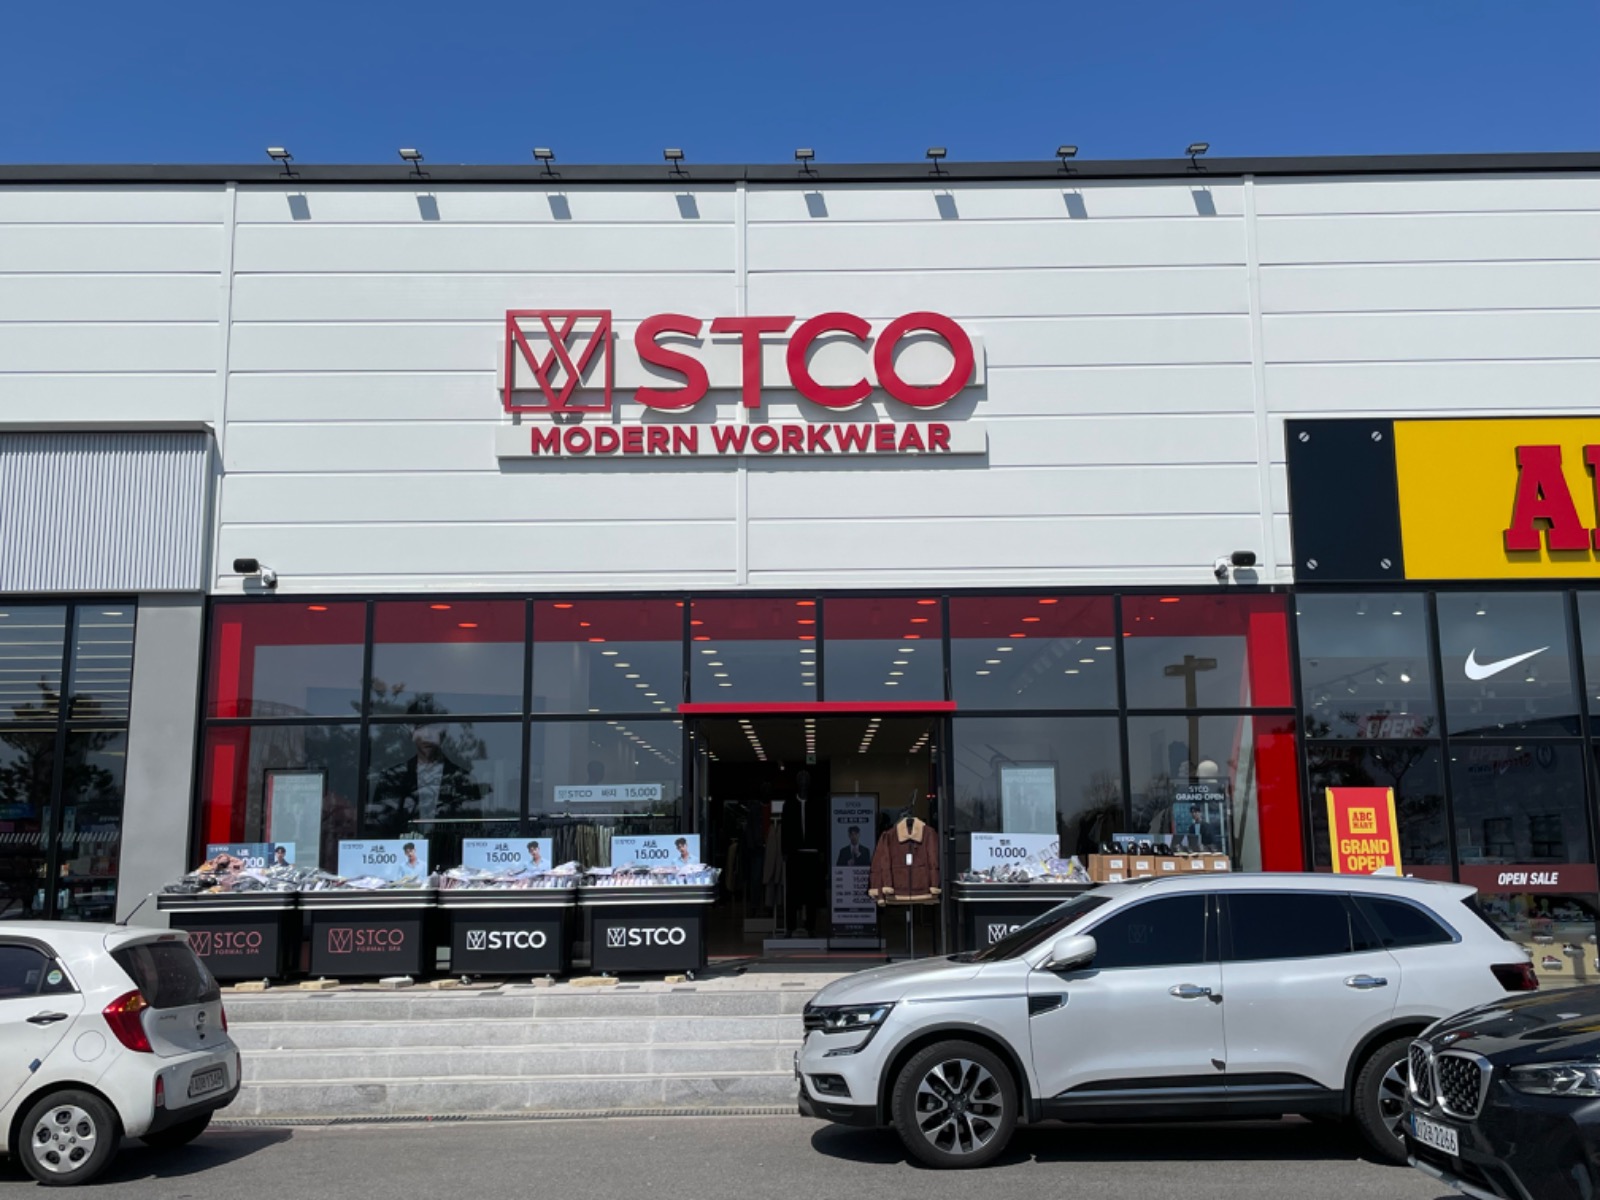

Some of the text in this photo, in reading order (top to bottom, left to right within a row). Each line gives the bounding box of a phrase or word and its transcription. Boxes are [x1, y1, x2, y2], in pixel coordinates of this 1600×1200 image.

[634, 310, 975, 411] STCO
[531, 422, 951, 455] MODERN WORKWEAR
[1504, 444, 1600, 552] A
[568, 790, 593, 798] STCO
[624, 787, 658, 798] 15,000
[1175, 793, 1225, 801] GRAND OPEN
[1351, 811, 1373, 822] ABC
[1352, 821, 1374, 830] MART
[634, 849, 669, 860] 15,000
[988, 847, 1027, 859] 10,000
[1340, 839, 1390, 855] GRAND
[362, 854, 397, 865] 15,000
[486, 852, 521, 863] 15,000
[1347, 855, 1386, 872] OPEN
[1498, 872, 1560, 886] OPEN SALE
[213, 931, 262, 949] STCO
[355, 928, 404, 946] STCO
[488, 930, 547, 949] STCO
[628, 927, 686, 946] STCO
